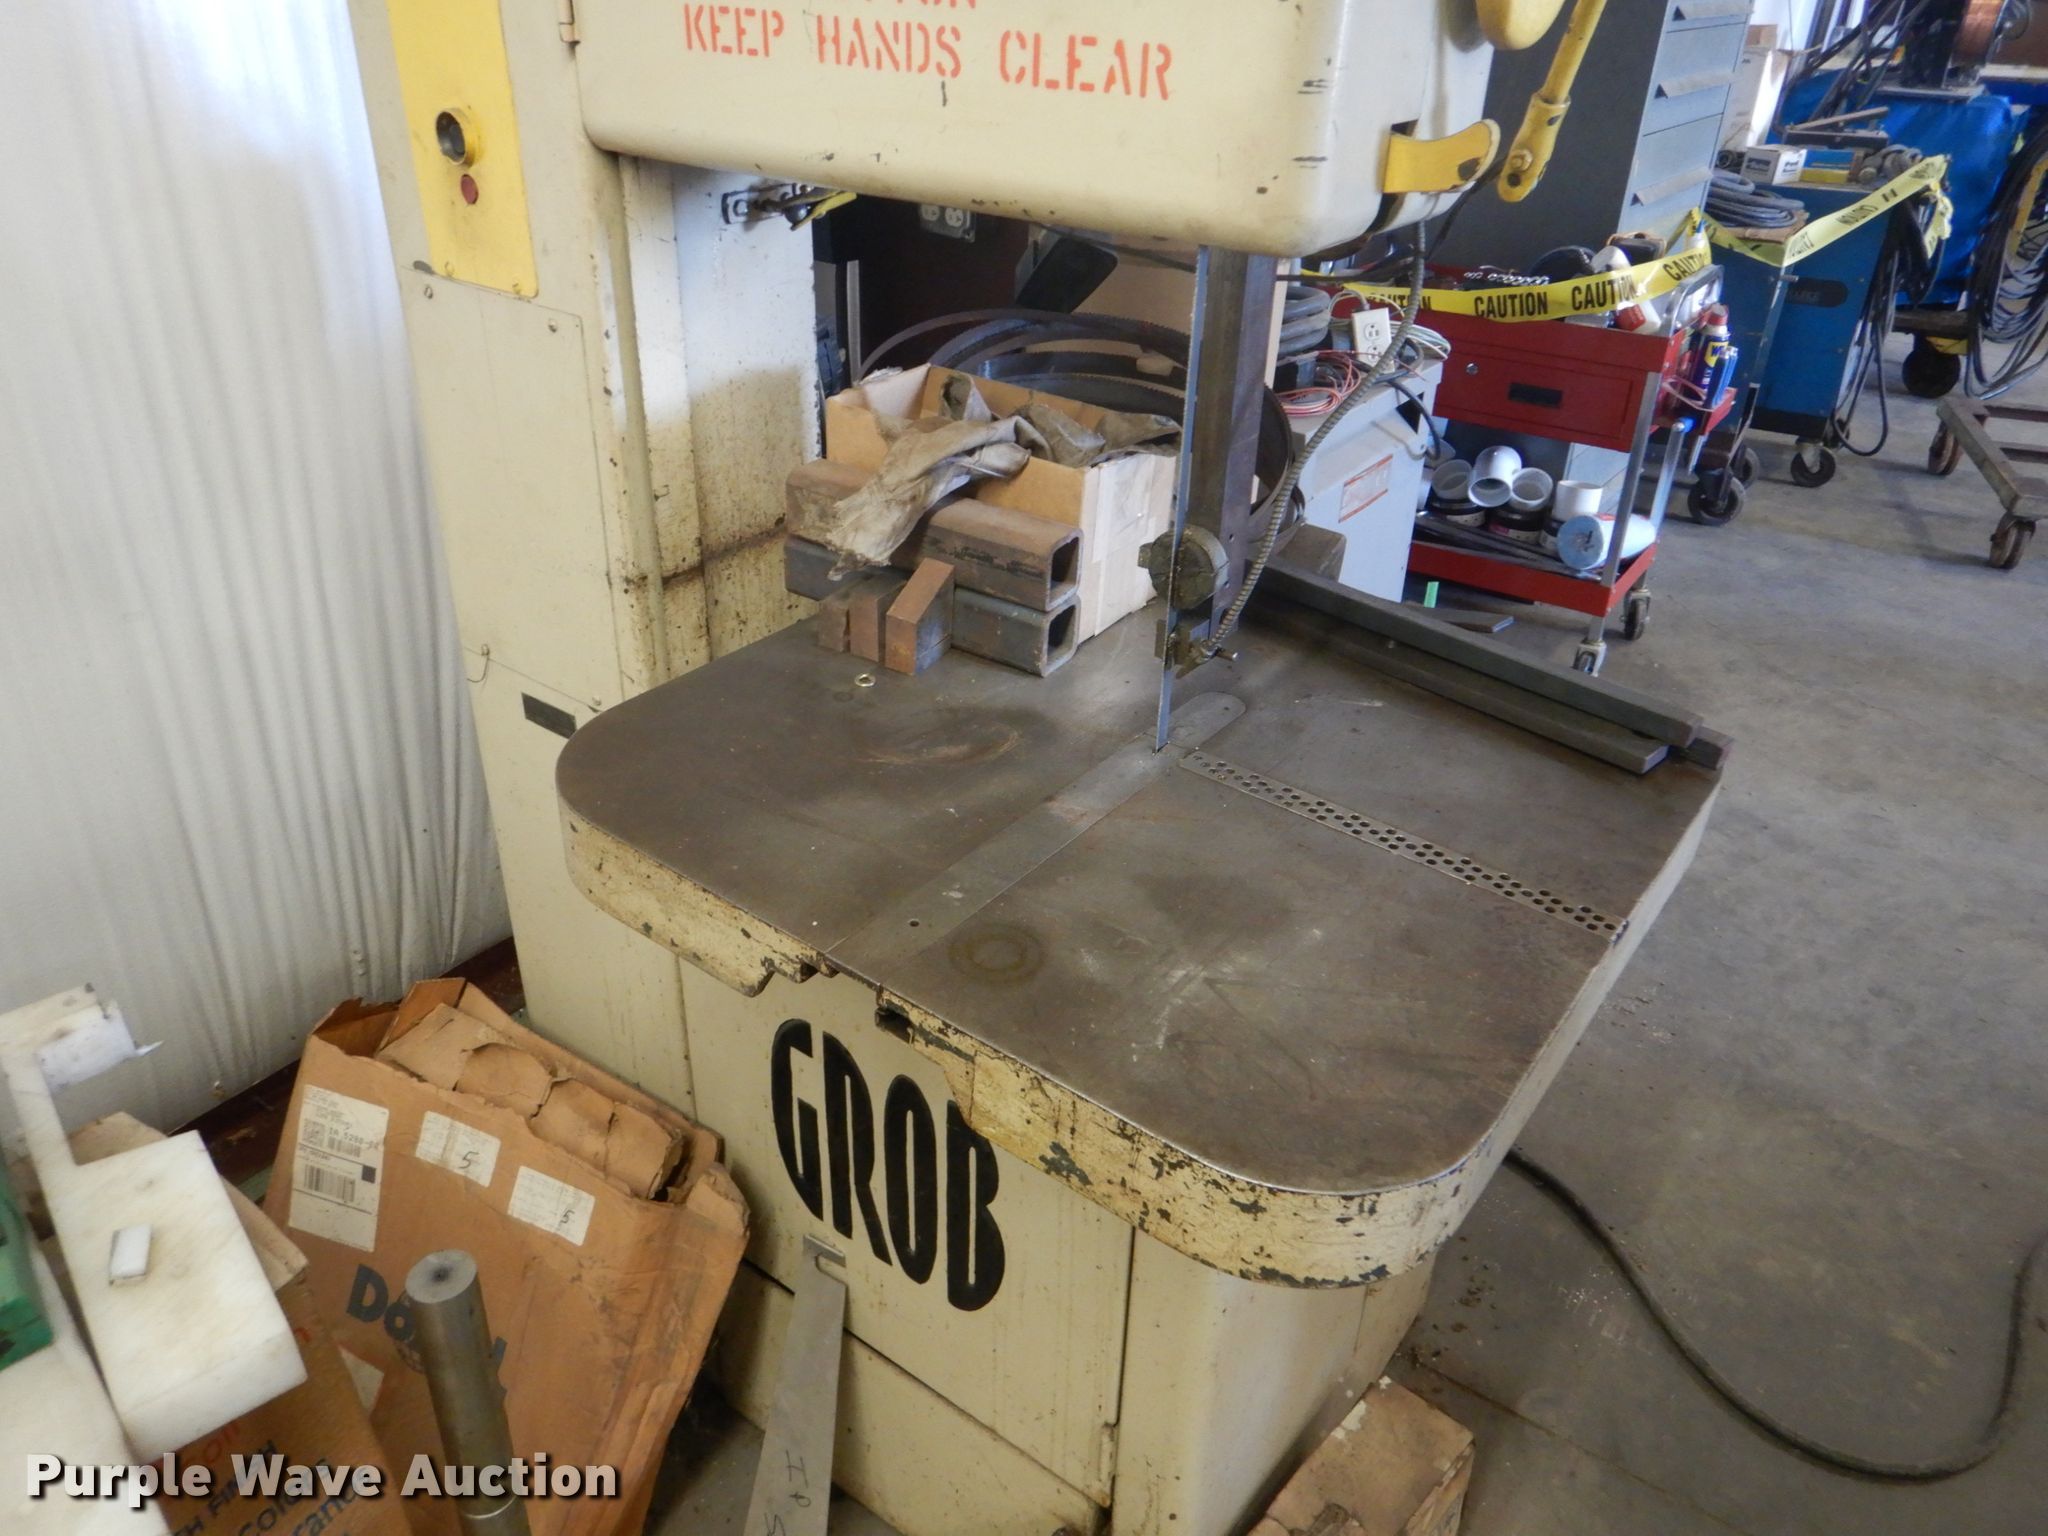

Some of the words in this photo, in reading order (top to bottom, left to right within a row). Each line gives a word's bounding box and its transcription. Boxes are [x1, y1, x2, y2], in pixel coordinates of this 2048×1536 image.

[683, 4, 785, 57] KEEP
[816, 14, 962, 79] HANDS
[998, 29, 1173, 101] CLEAR
[1473, 290, 1548, 319] CAUTION
[1571, 274, 1638, 311] CAUTION
[459, 1150, 480, 1170] 5
[770, 1016, 1006, 1312] GROB
[558, 1208, 576, 1225] 5
